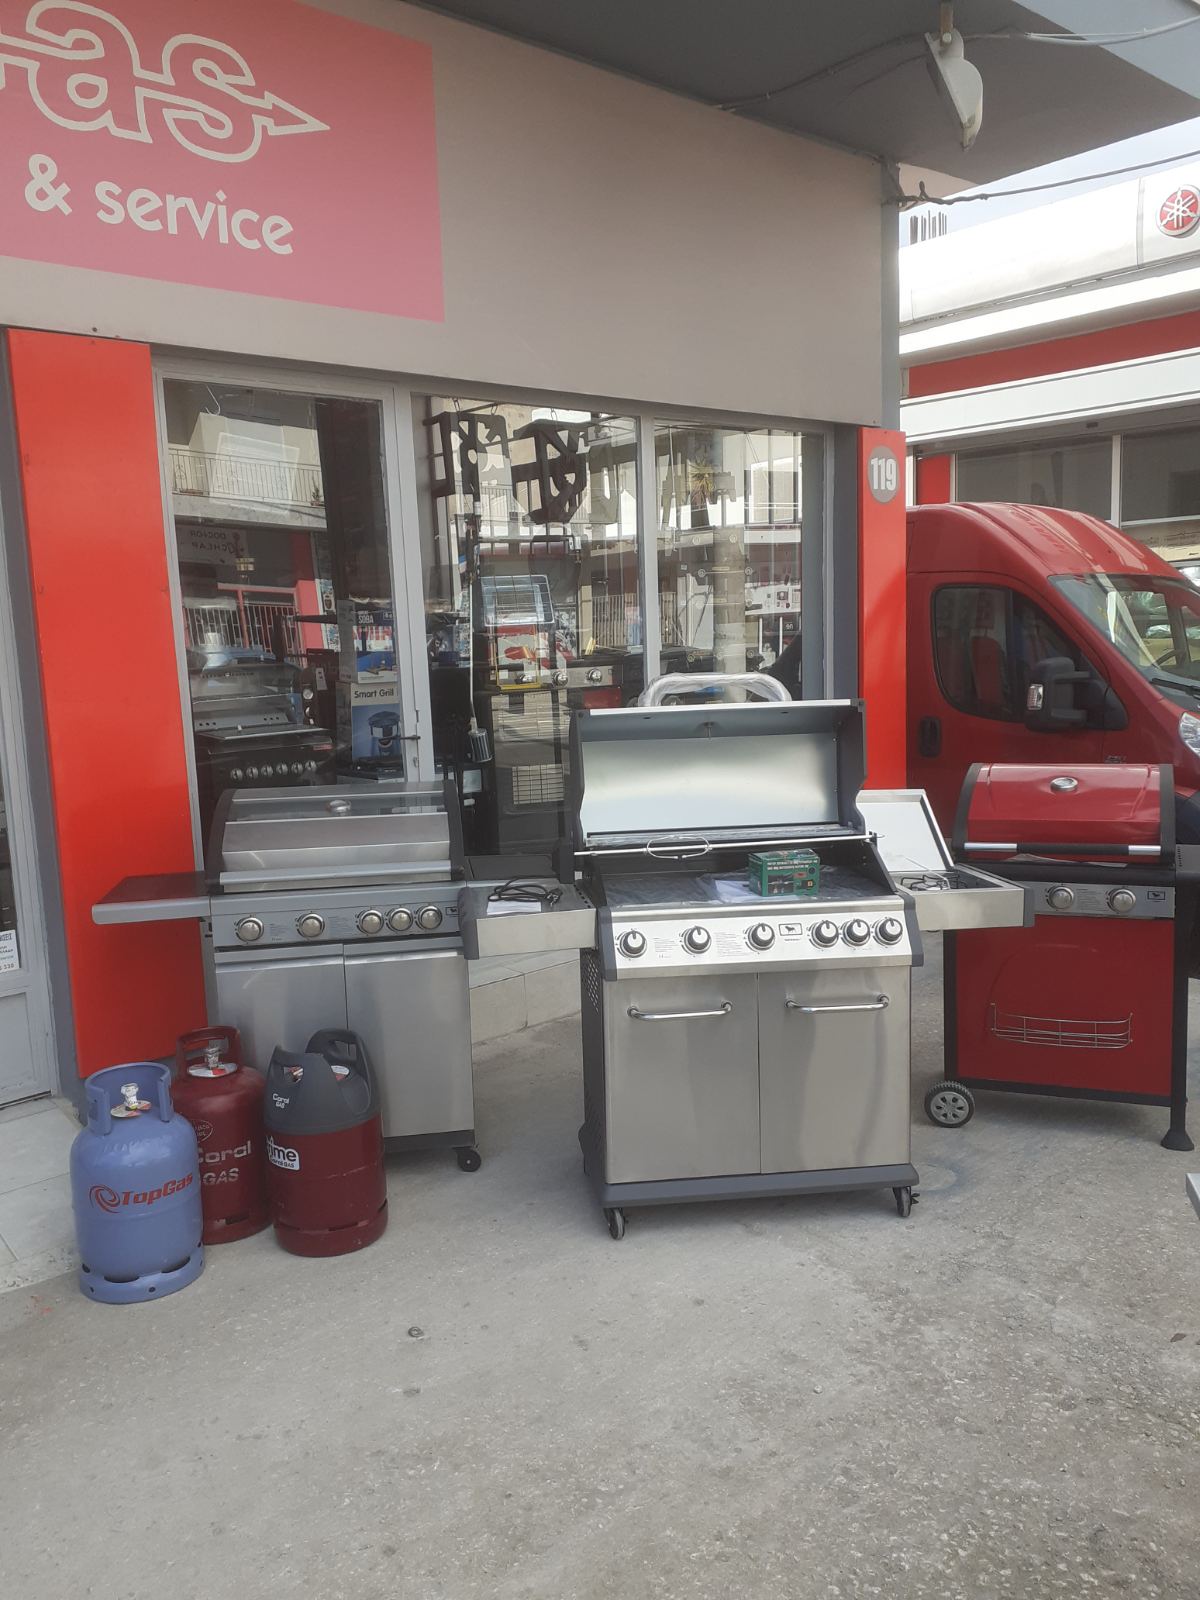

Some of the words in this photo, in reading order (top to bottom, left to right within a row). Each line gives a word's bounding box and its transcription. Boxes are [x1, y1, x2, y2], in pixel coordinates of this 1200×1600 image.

[0, 0, 330, 163] as
[25, 154, 72, 216] &
[95, 181, 293, 255] service
[871, 457, 897, 491] 119
[354, 689, 377, 699] Smart
[379, 687, 394, 698] Grill
[272, 1093, 290, 1104] Coral
[121, 1172, 194, 1206] TopGas
[202, 1167, 240, 1185] GAS
